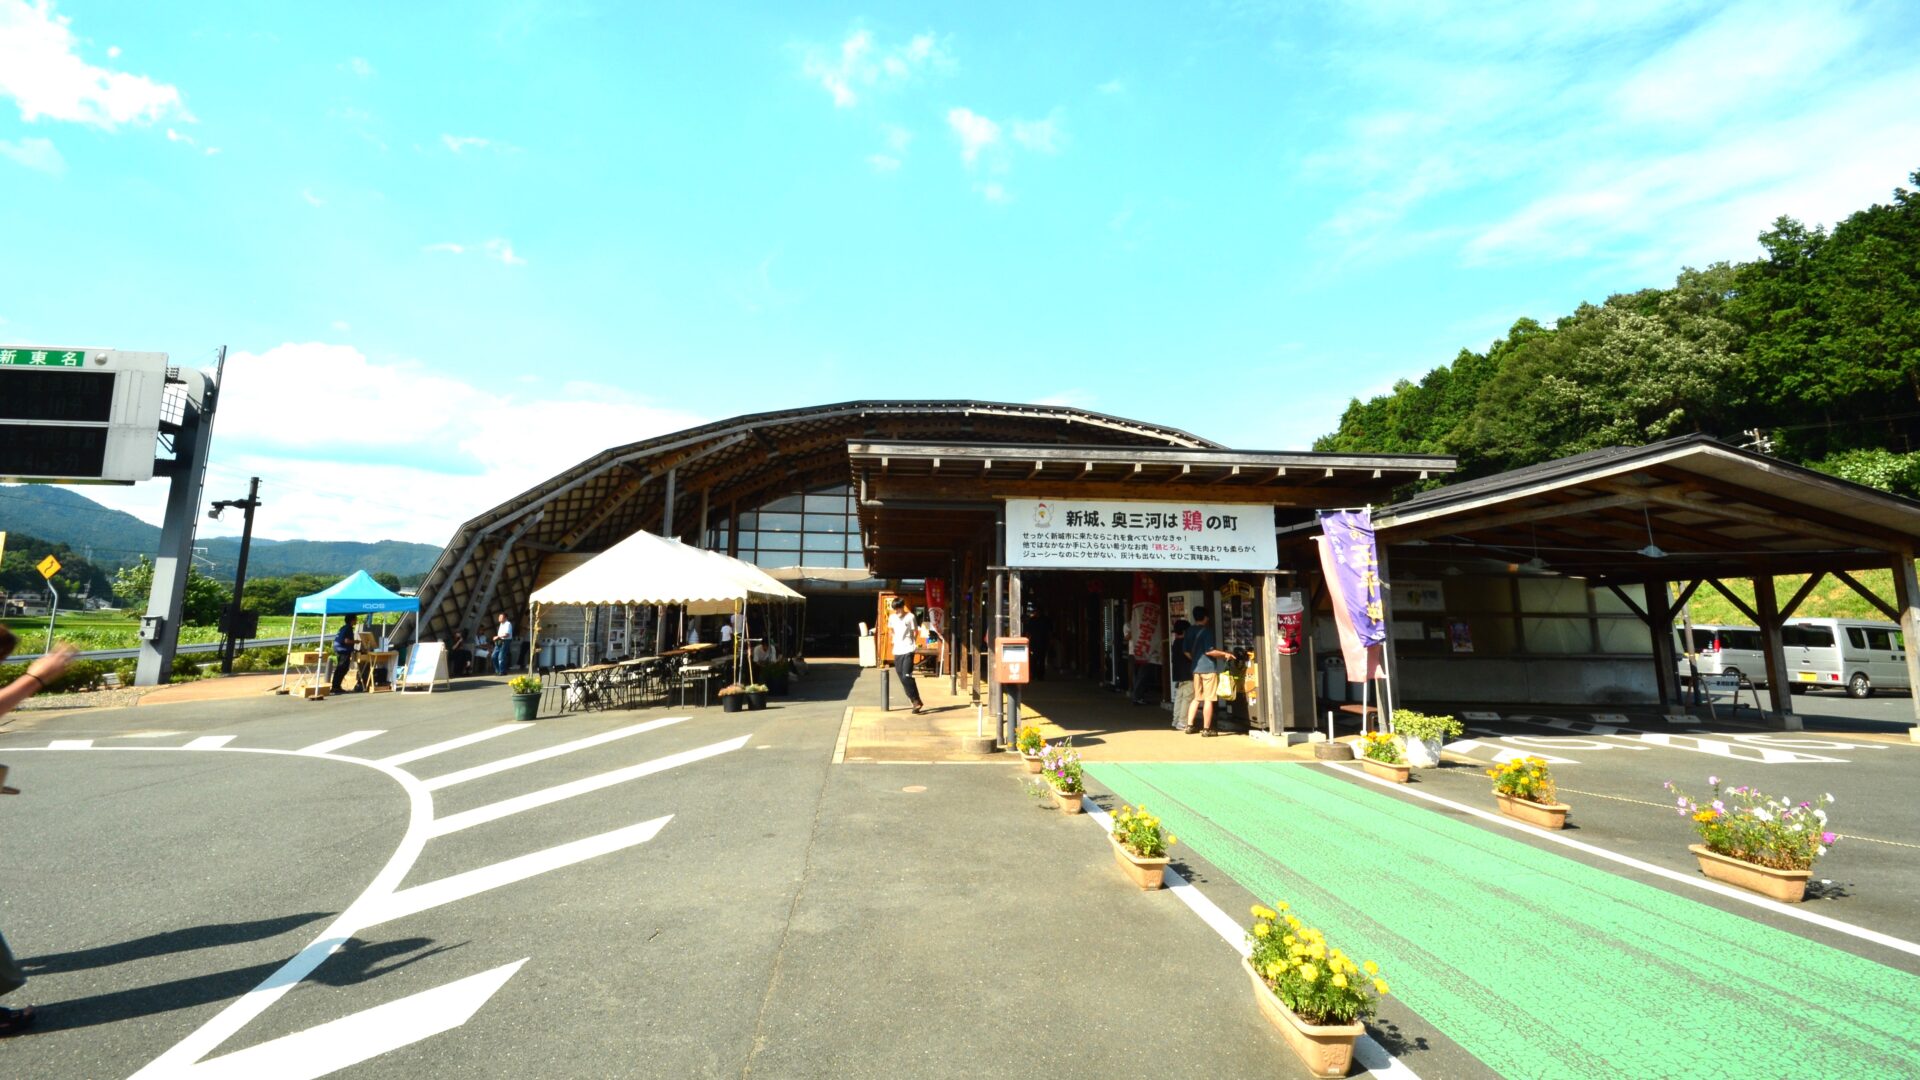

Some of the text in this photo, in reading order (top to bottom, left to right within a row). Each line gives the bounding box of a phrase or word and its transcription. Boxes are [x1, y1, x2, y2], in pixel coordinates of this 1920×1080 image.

[0, 349, 77, 366] 新東名
[1066, 510, 1238, 532] 新城、奥三河は鶏の町
